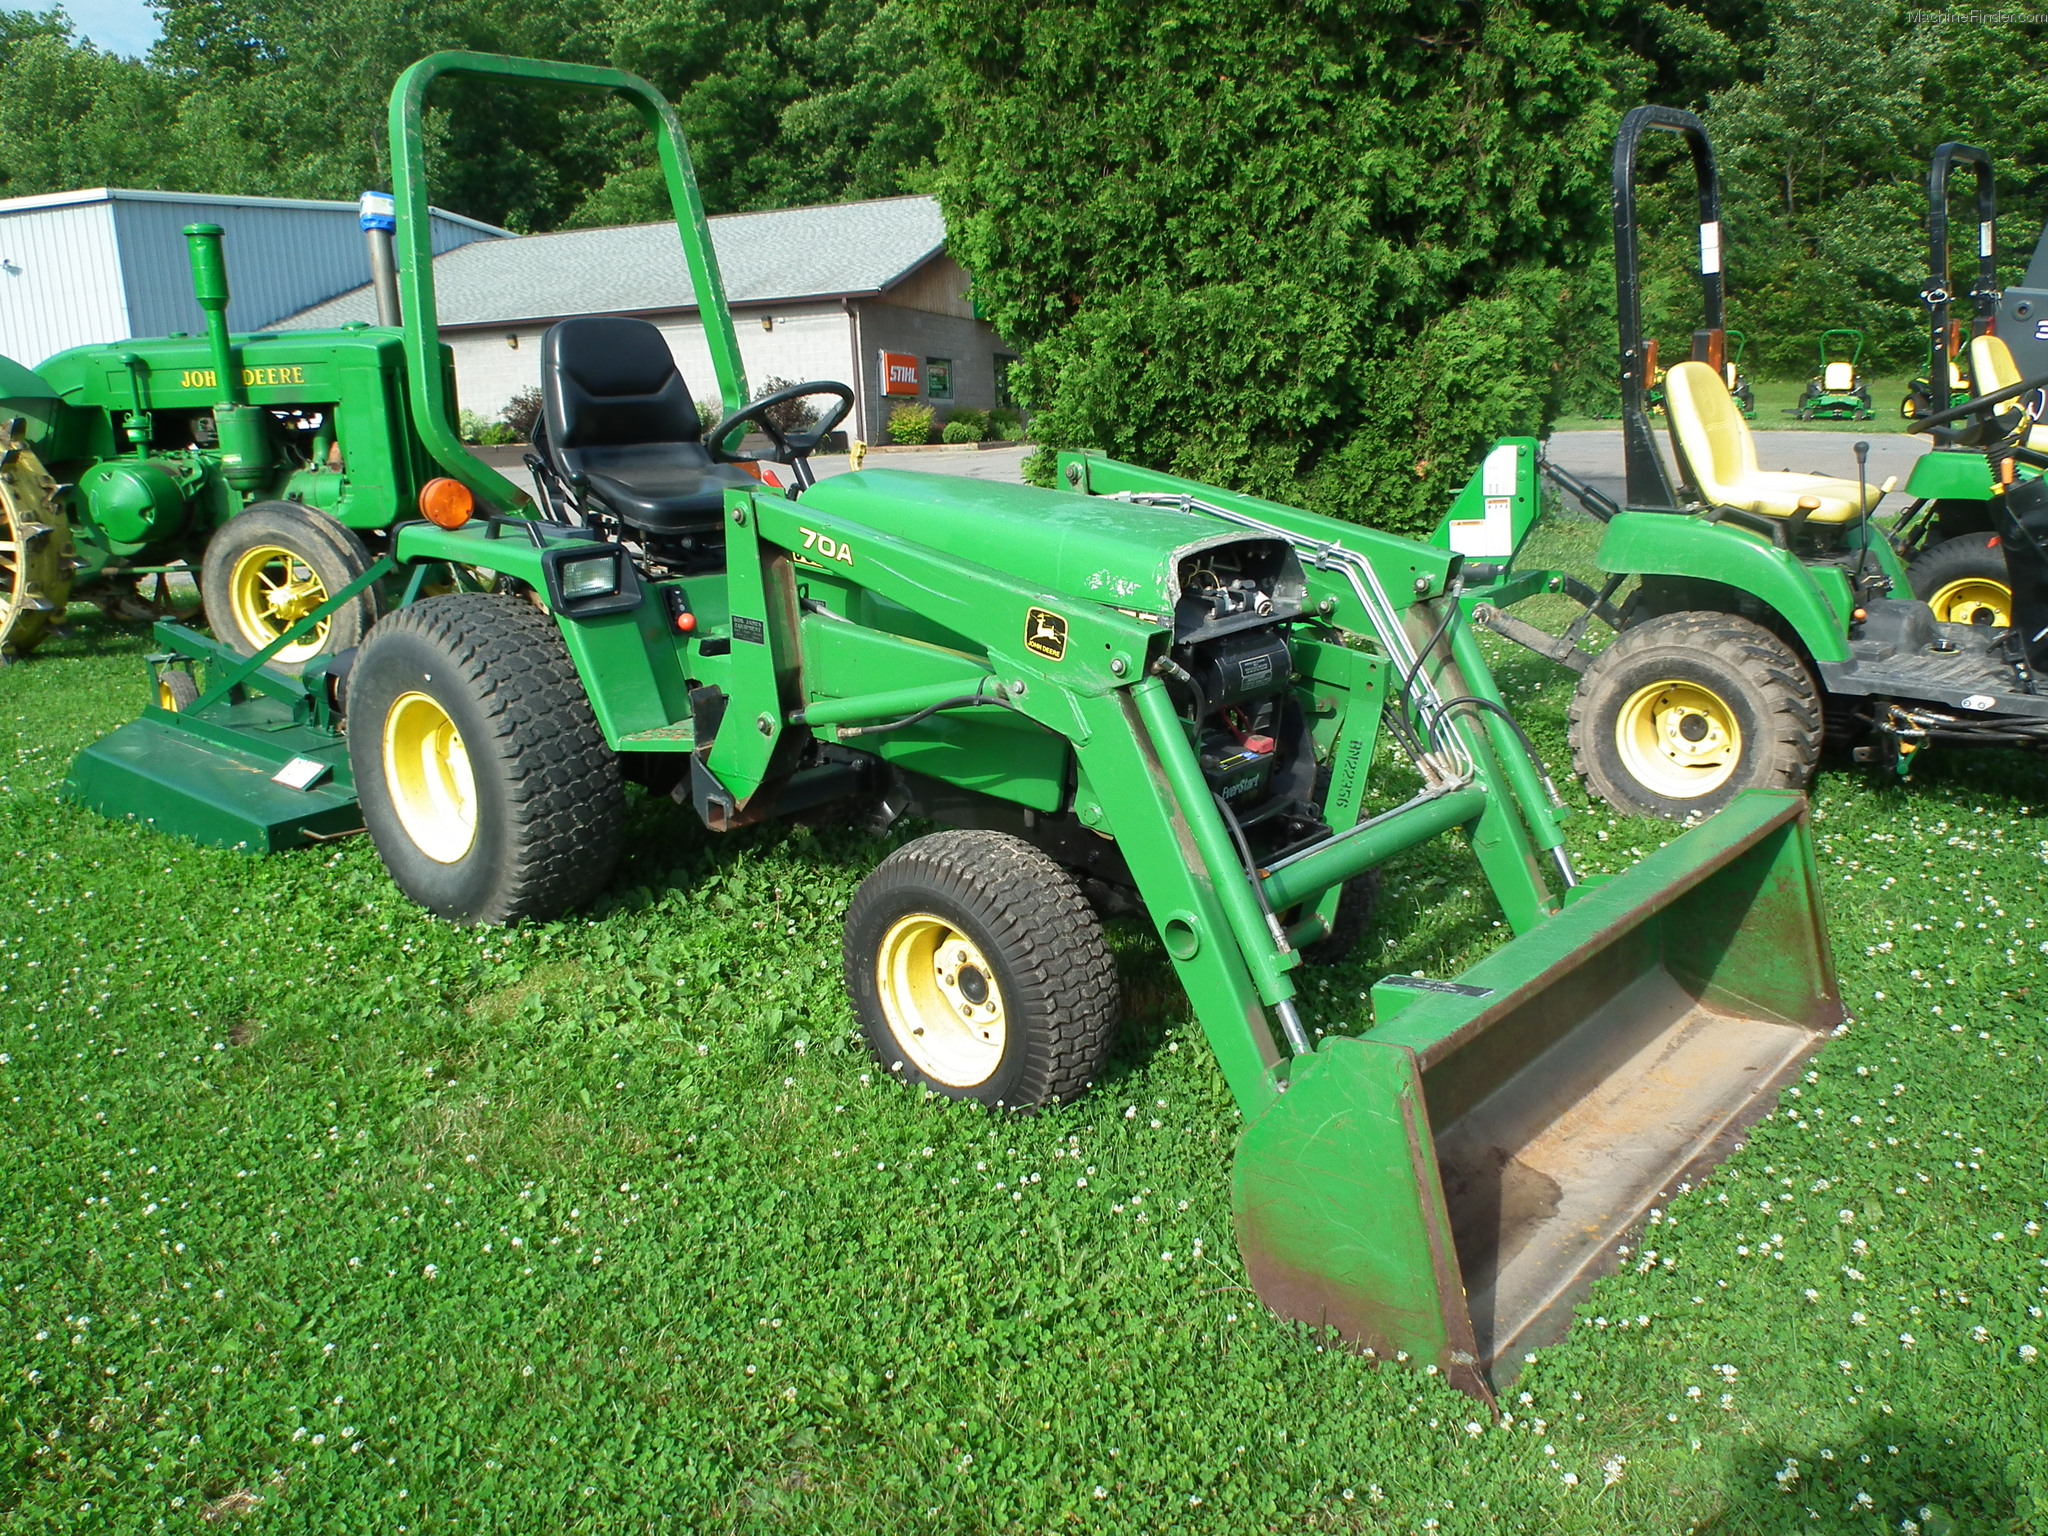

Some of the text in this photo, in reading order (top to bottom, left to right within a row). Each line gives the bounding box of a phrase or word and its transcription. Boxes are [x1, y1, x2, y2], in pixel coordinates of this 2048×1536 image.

[181, 367, 304, 388] JOH DEERE
[890, 365, 918, 384] STIHL
[799, 526, 854, 567] 70A
[1028, 641, 1060, 658] JOHN DEERE
